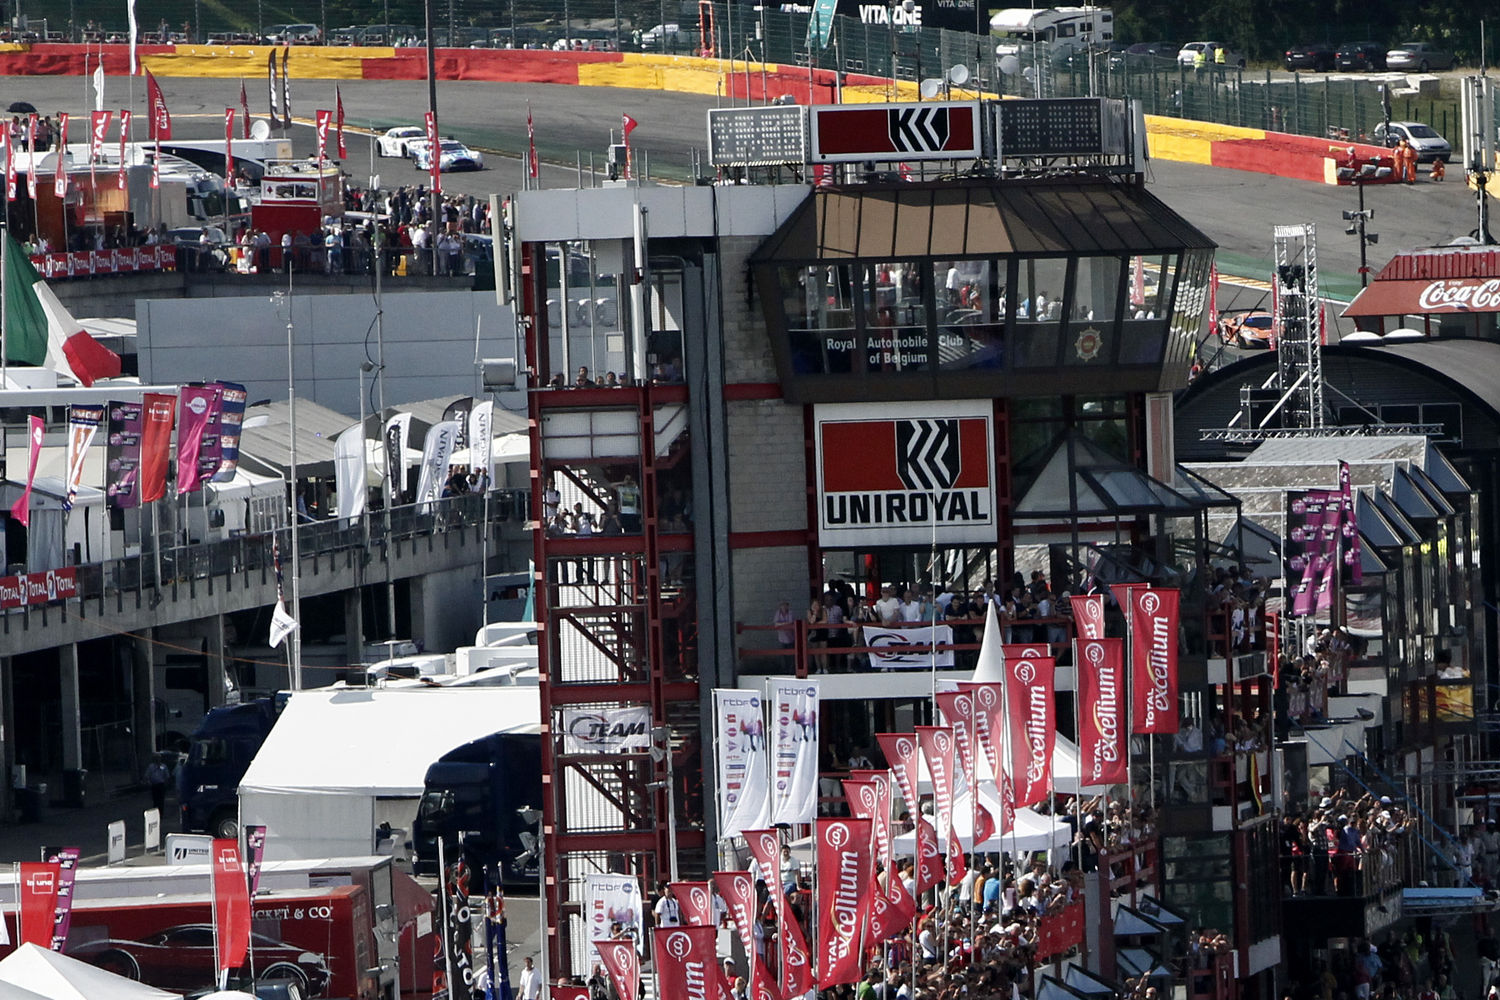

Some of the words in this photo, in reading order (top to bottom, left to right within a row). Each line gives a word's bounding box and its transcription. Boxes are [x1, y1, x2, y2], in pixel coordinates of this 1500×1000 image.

[73, 257, 89, 270] TOTAL
[95, 255, 111, 268] TOTAL
[117, 253, 133, 267] TOTAL
[139, 251, 155, 265] TOTAL
[160, 250, 176, 264] TOTAL
[51, 259, 67, 272] TOTAL
[826, 338, 856, 352] Royal
[867, 336, 928, 348] Automobile
[938, 335, 964, 346] Club
[869, 353, 880, 364] of
[884, 353, 928, 365] Belgium
[826, 491, 989, 524] UNIROYAL
[28, 580, 47, 594] TOTAL
[56, 576, 75, 591] TOTAL
[1151, 617, 1169, 712] excellium
[1100, 667, 1118, 762] excellium
[1145, 688, 1155, 728] TOTAL
[588, 721, 645, 737] TEAM
[1026, 685, 1046, 782] excellium
[1093, 740, 1103, 780] TOTAL
[836, 851, 857, 958] excellium
[294, 907, 304, 919] &
